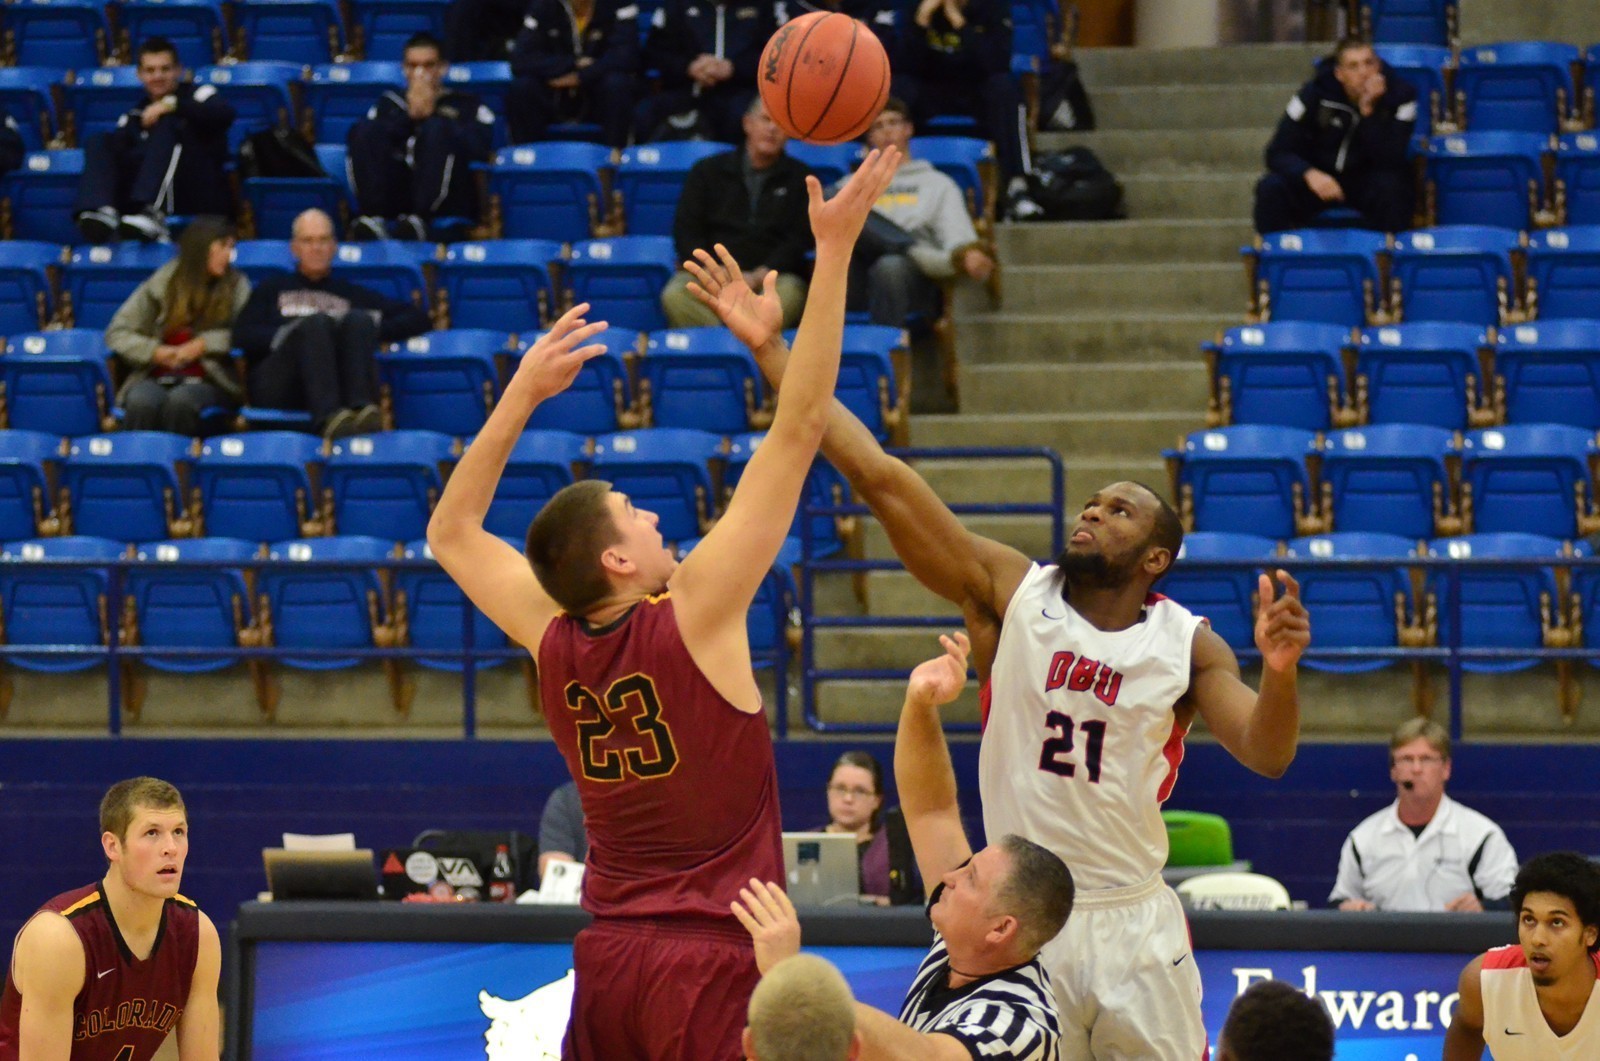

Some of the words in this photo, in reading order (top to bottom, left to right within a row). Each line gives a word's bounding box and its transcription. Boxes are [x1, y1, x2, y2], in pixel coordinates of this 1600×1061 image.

[764, 25, 796, 84] NCAA
[564, 672, 680, 782] 23
[1038, 709, 1107, 785] 21
